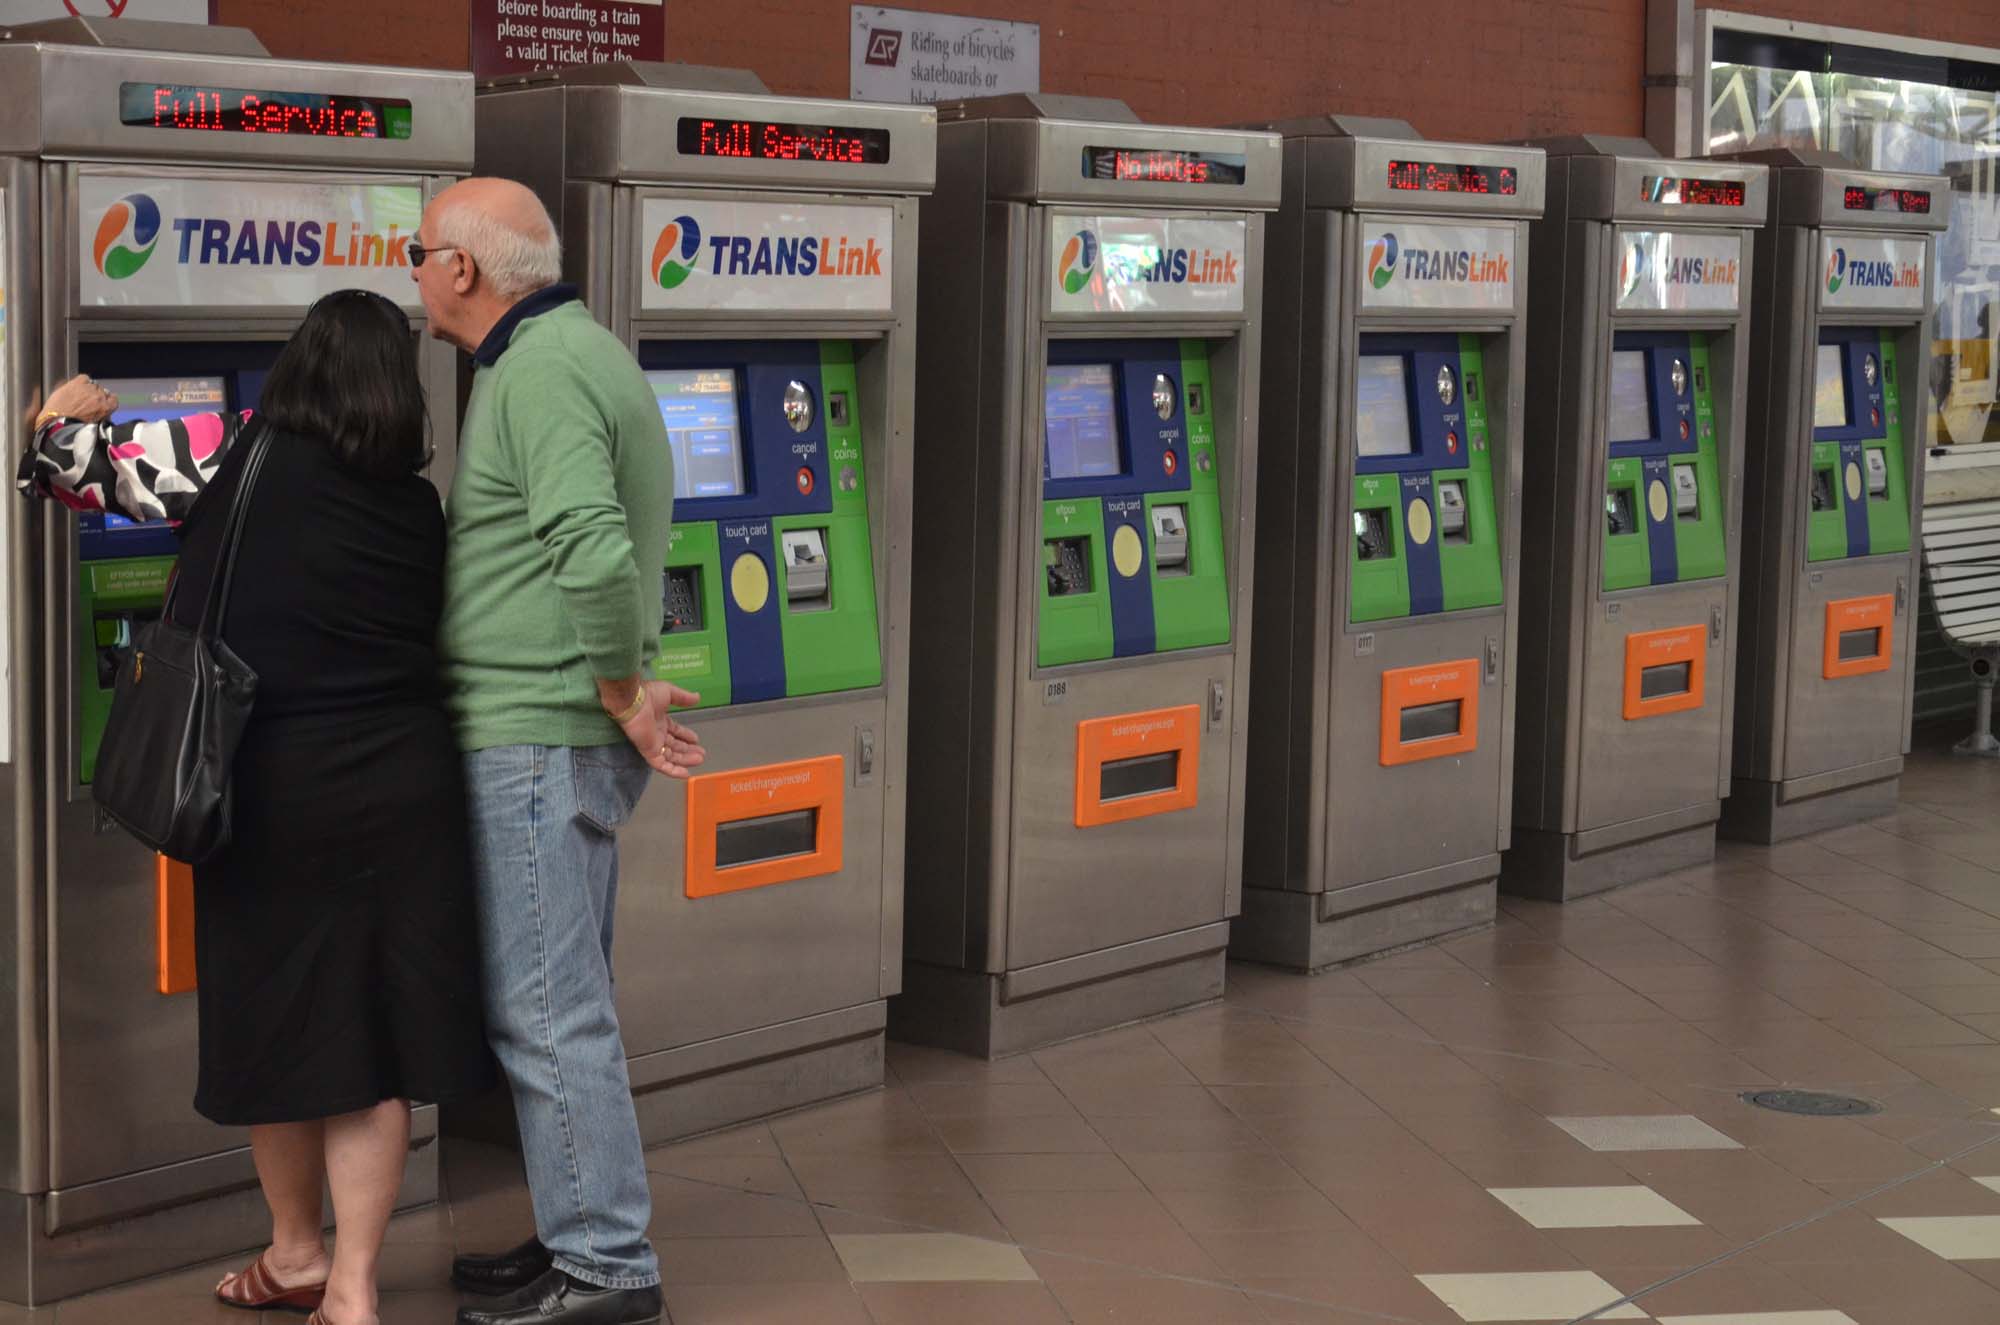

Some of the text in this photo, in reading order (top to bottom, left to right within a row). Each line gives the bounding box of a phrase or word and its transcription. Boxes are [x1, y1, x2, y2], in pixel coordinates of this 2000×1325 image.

[498, 0, 641, 27] Before boarding a train
[498, 18, 640, 48] please ensure you have
[911, 31, 1015, 64] Riding of bicycles
[505, 42, 633, 64] a valid Ticket for the
[911, 60, 998, 88] skateboards or
[153, 89, 223, 130] Full
[241, 94, 377, 138] Service
[701, 121, 864, 163] Full Service
[1116, 151, 1209, 183] No Notes
[1387, 161, 1421, 190] Full
[1426, 164, 1489, 193] Service
[173, 218, 410, 267] TRANSLink
[709, 236, 883, 276] TRANSLink
[1403, 248, 1509, 284] TRANSLink
[792, 441, 817, 454] cancel
[1159, 428, 1179, 440] cancel
[834, 447, 858, 460] coins
[1055, 504, 1076, 516] eftpos
[1108, 499, 1141, 512] touch card
[725, 523, 768, 538] touch card
